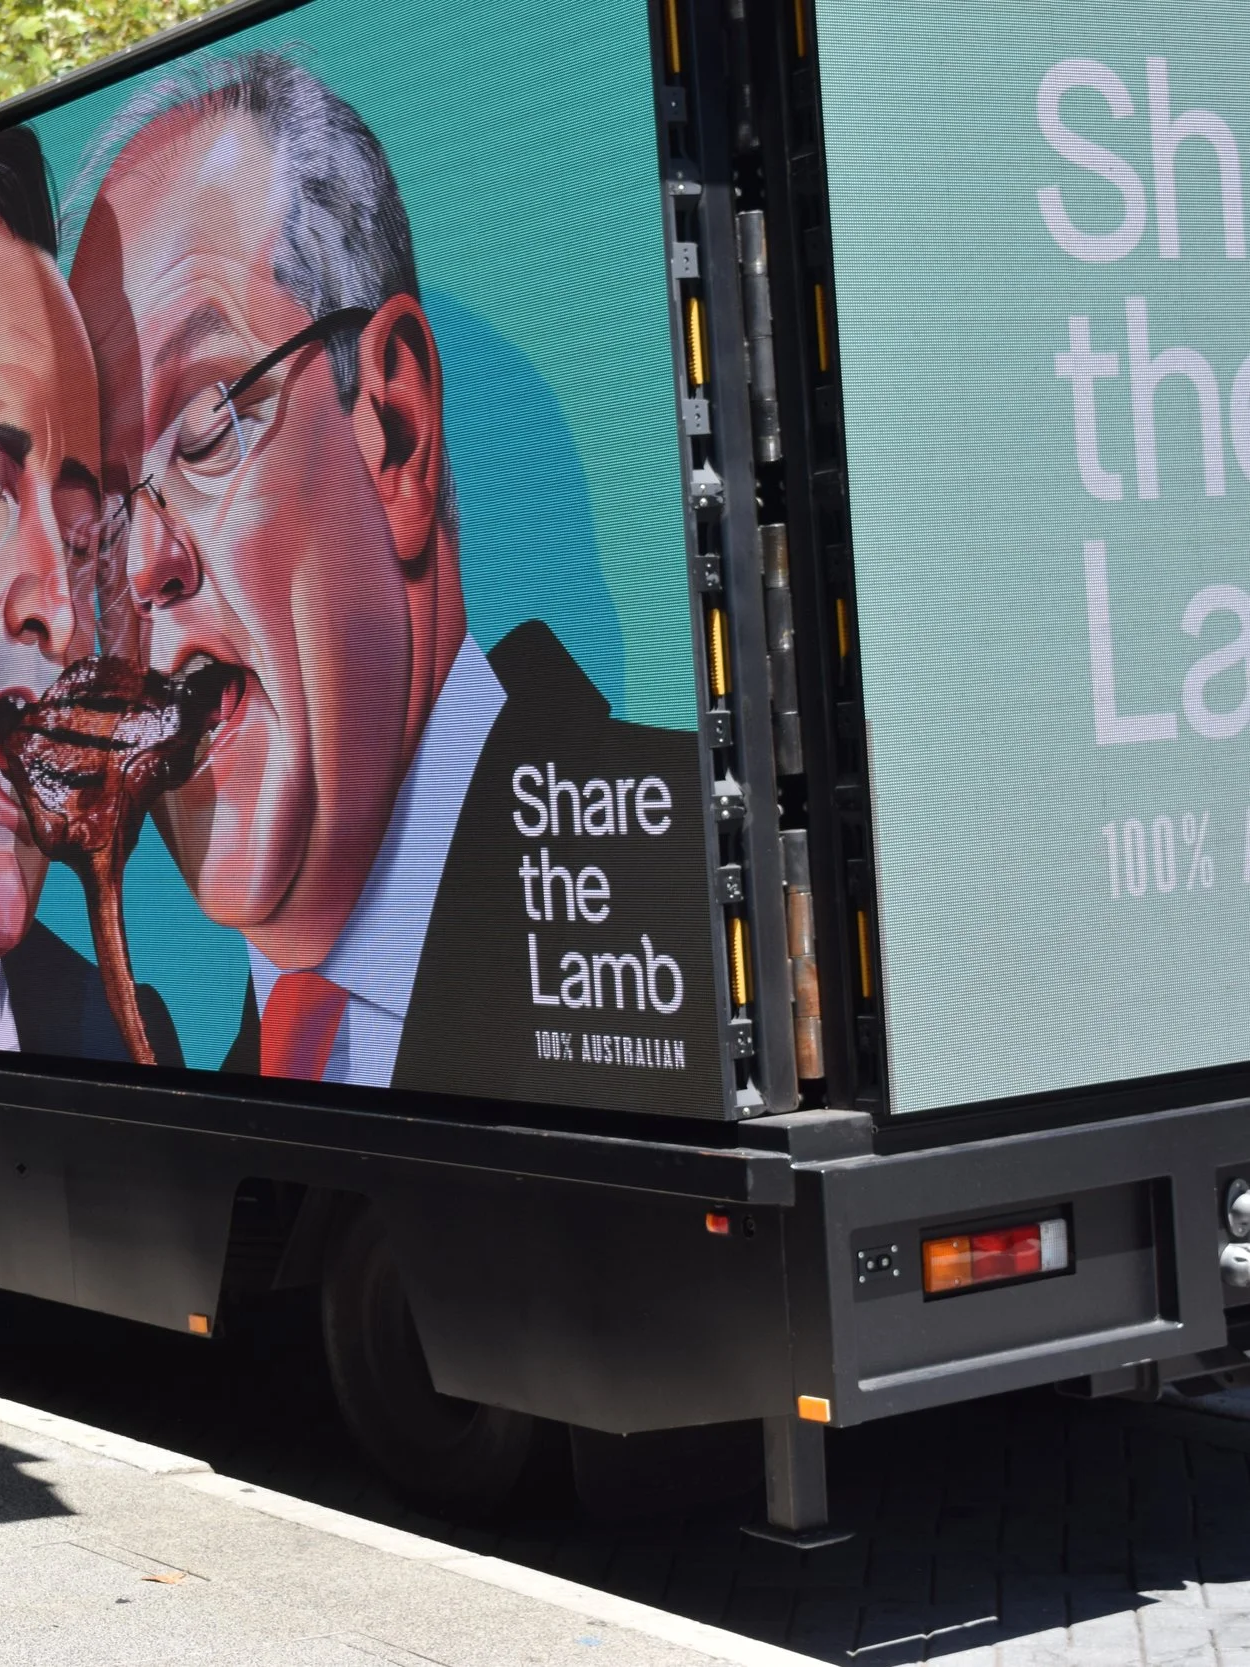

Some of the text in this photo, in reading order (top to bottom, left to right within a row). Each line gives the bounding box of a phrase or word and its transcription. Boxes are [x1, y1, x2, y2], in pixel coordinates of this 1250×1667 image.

[1053, 296, 1250, 500] th
[511, 762, 673, 837] Share
[518, 847, 611, 923] the
[1101, 811, 1214, 900] 100%
[527, 933, 685, 1014] Lamb
[534, 1030, 686, 1070] 100% AUSTRALIAN
